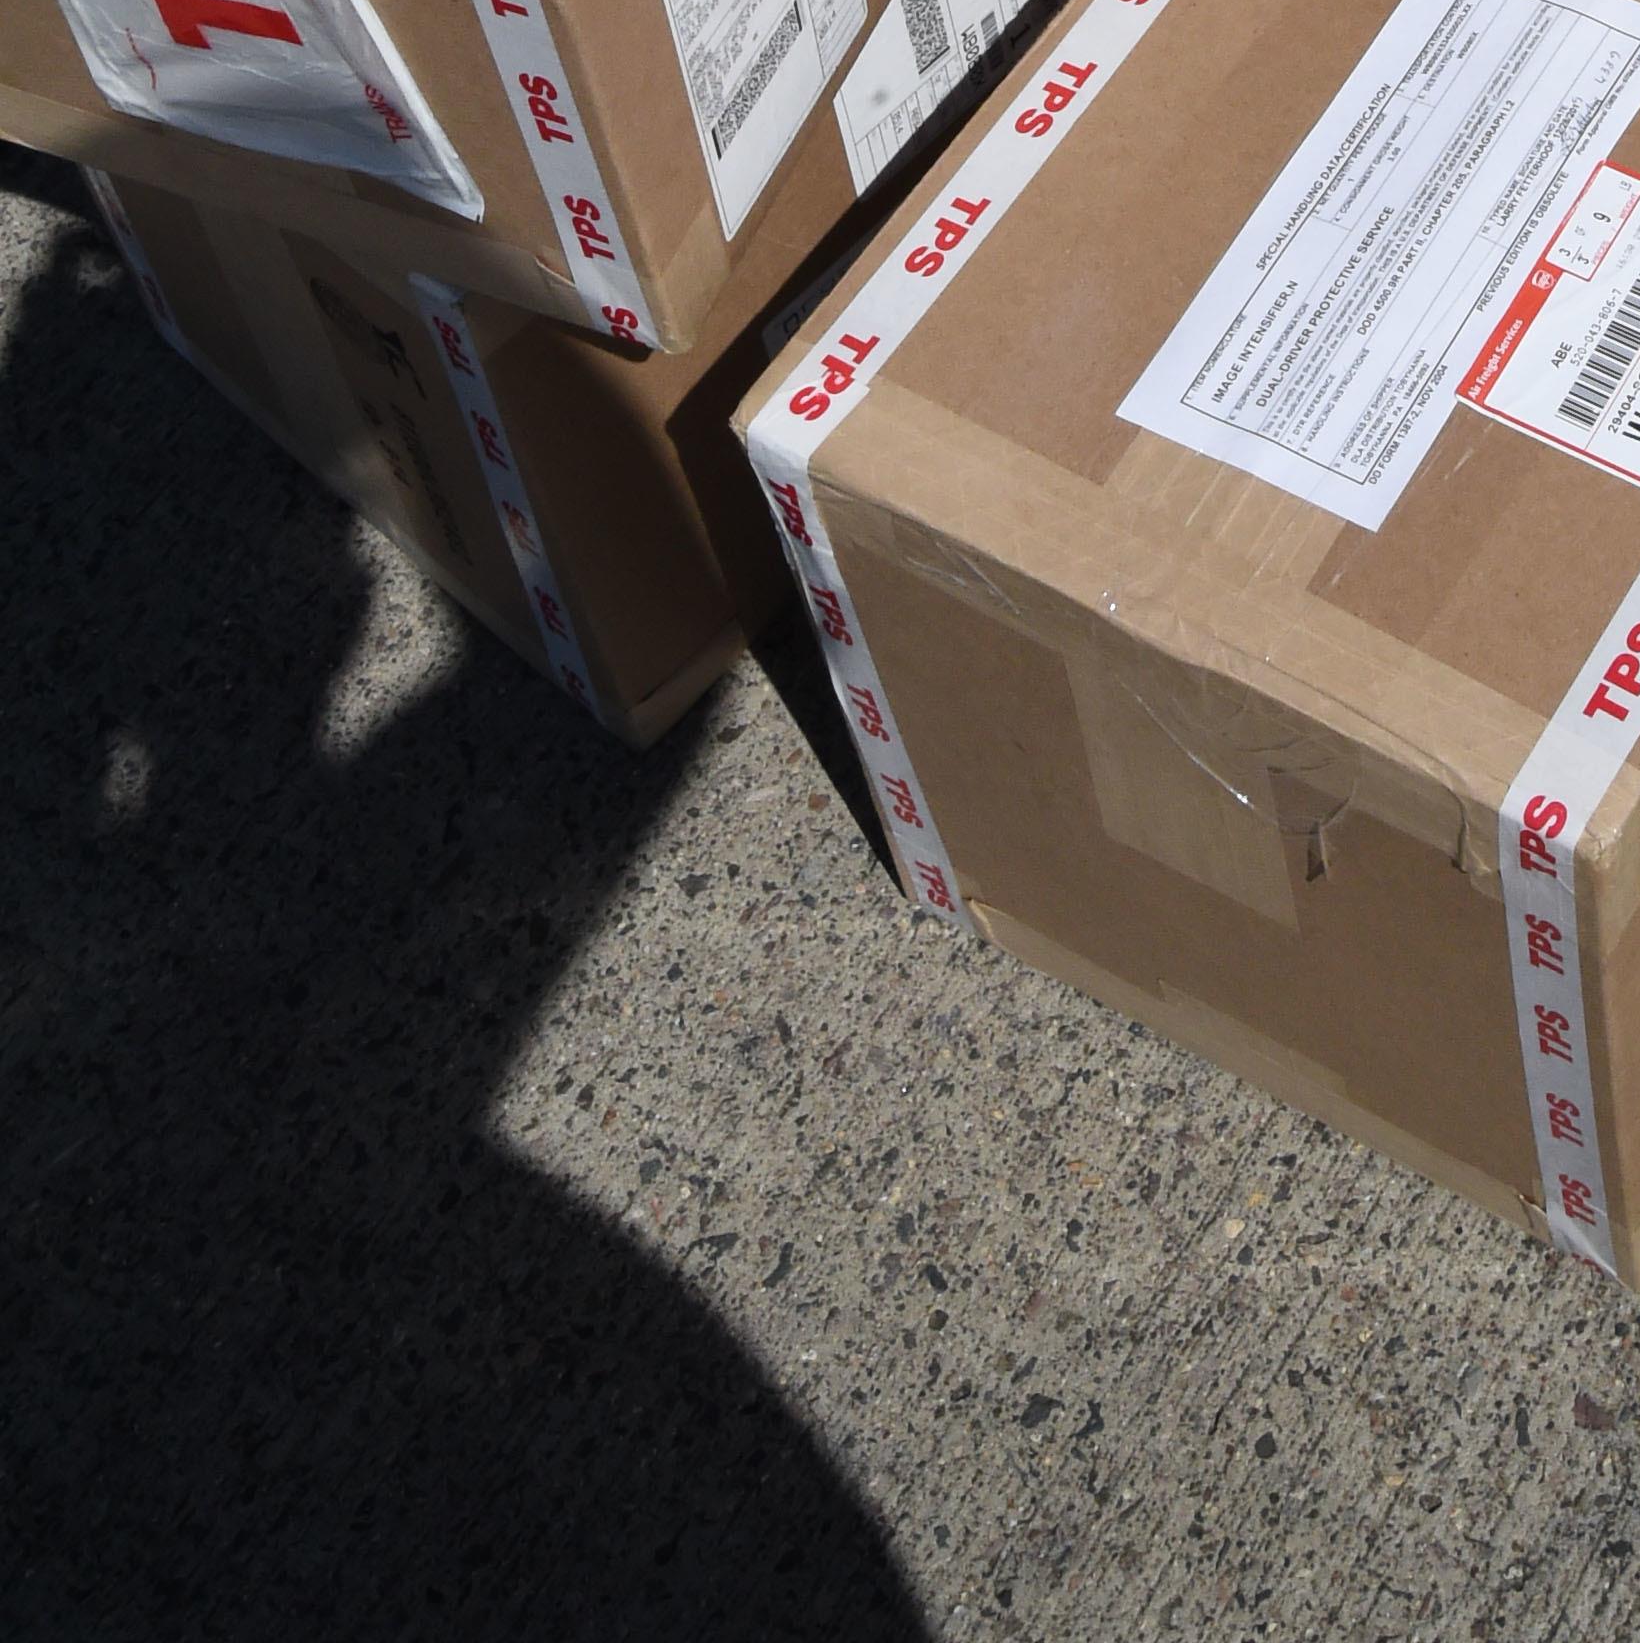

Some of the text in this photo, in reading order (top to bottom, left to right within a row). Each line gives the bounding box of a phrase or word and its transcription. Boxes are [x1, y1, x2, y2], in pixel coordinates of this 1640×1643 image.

[518, 73, 574, 144] TPS
[1014, 62, 1098, 139] TPS
[1255, 82, 1392, 270] SPECIAL HANDLING DATA/CERTIFICATION
[563, 194, 616, 262] TPS
[904, 197, 991, 279] TPS
[1356, 312, 1377, 335] DOD
[1371, 273, 1402, 312] 4500.9R
[1396, 245, 1421, 274] PART
[1421, 189, 1457, 236] CHAPTER
[1450, 169, 1470, 189] 205,
[1463, 111, 1508, 170] PARAGRAPH
[1475, 171, 1570, 312] PREVIOUS EDITION IS OBSOLETE
[1495, 197, 1520, 227] LARRY
[1591, 210, 1612, 224] 9
[1557, 246, 1572, 257] 3
[1575, 253, 1591, 265] 3
[601, 304, 639, 345] PS
[1254, 327, 1314, 408] DUAL-DRIVER
[1307, 254, 1363, 327] PROTECTIVE
[1355, 205, 1394, 254] SERVICE
[1569, 287, 1623, 366] 520-043-806-7
[432, 315, 476, 378] TPS
[789, 334, 880, 422] TPS
[1465, 317, 1525, 400] Air Freight Services
[1548, 341, 1573, 368] ABE
[1210, 363, 1244, 403] IMAGE
[1349, 348, 1427, 463] DLA DISTRIBUTION TOBYHANNA
[1359, 404, 1404, 467] TOBYHANNA PA
[1366, 363, 1449, 485] DD FORM 1387-2, NOV 2004
[767, 476, 814, 548] TPS
[808, 584, 854, 647] TPS
[845, 682, 891, 744] TPS
[880, 772, 924, 830] TPS
[1519, 794, 1569, 879] TPS
[913, 859, 955, 913] TPS
[1525, 913, 1566, 977] TPS
[1533, 1003, 1576, 1064] TPS
[1545, 1092, 1585, 1149] TPS
[1558, 1173, 1599, 1227] TPS
